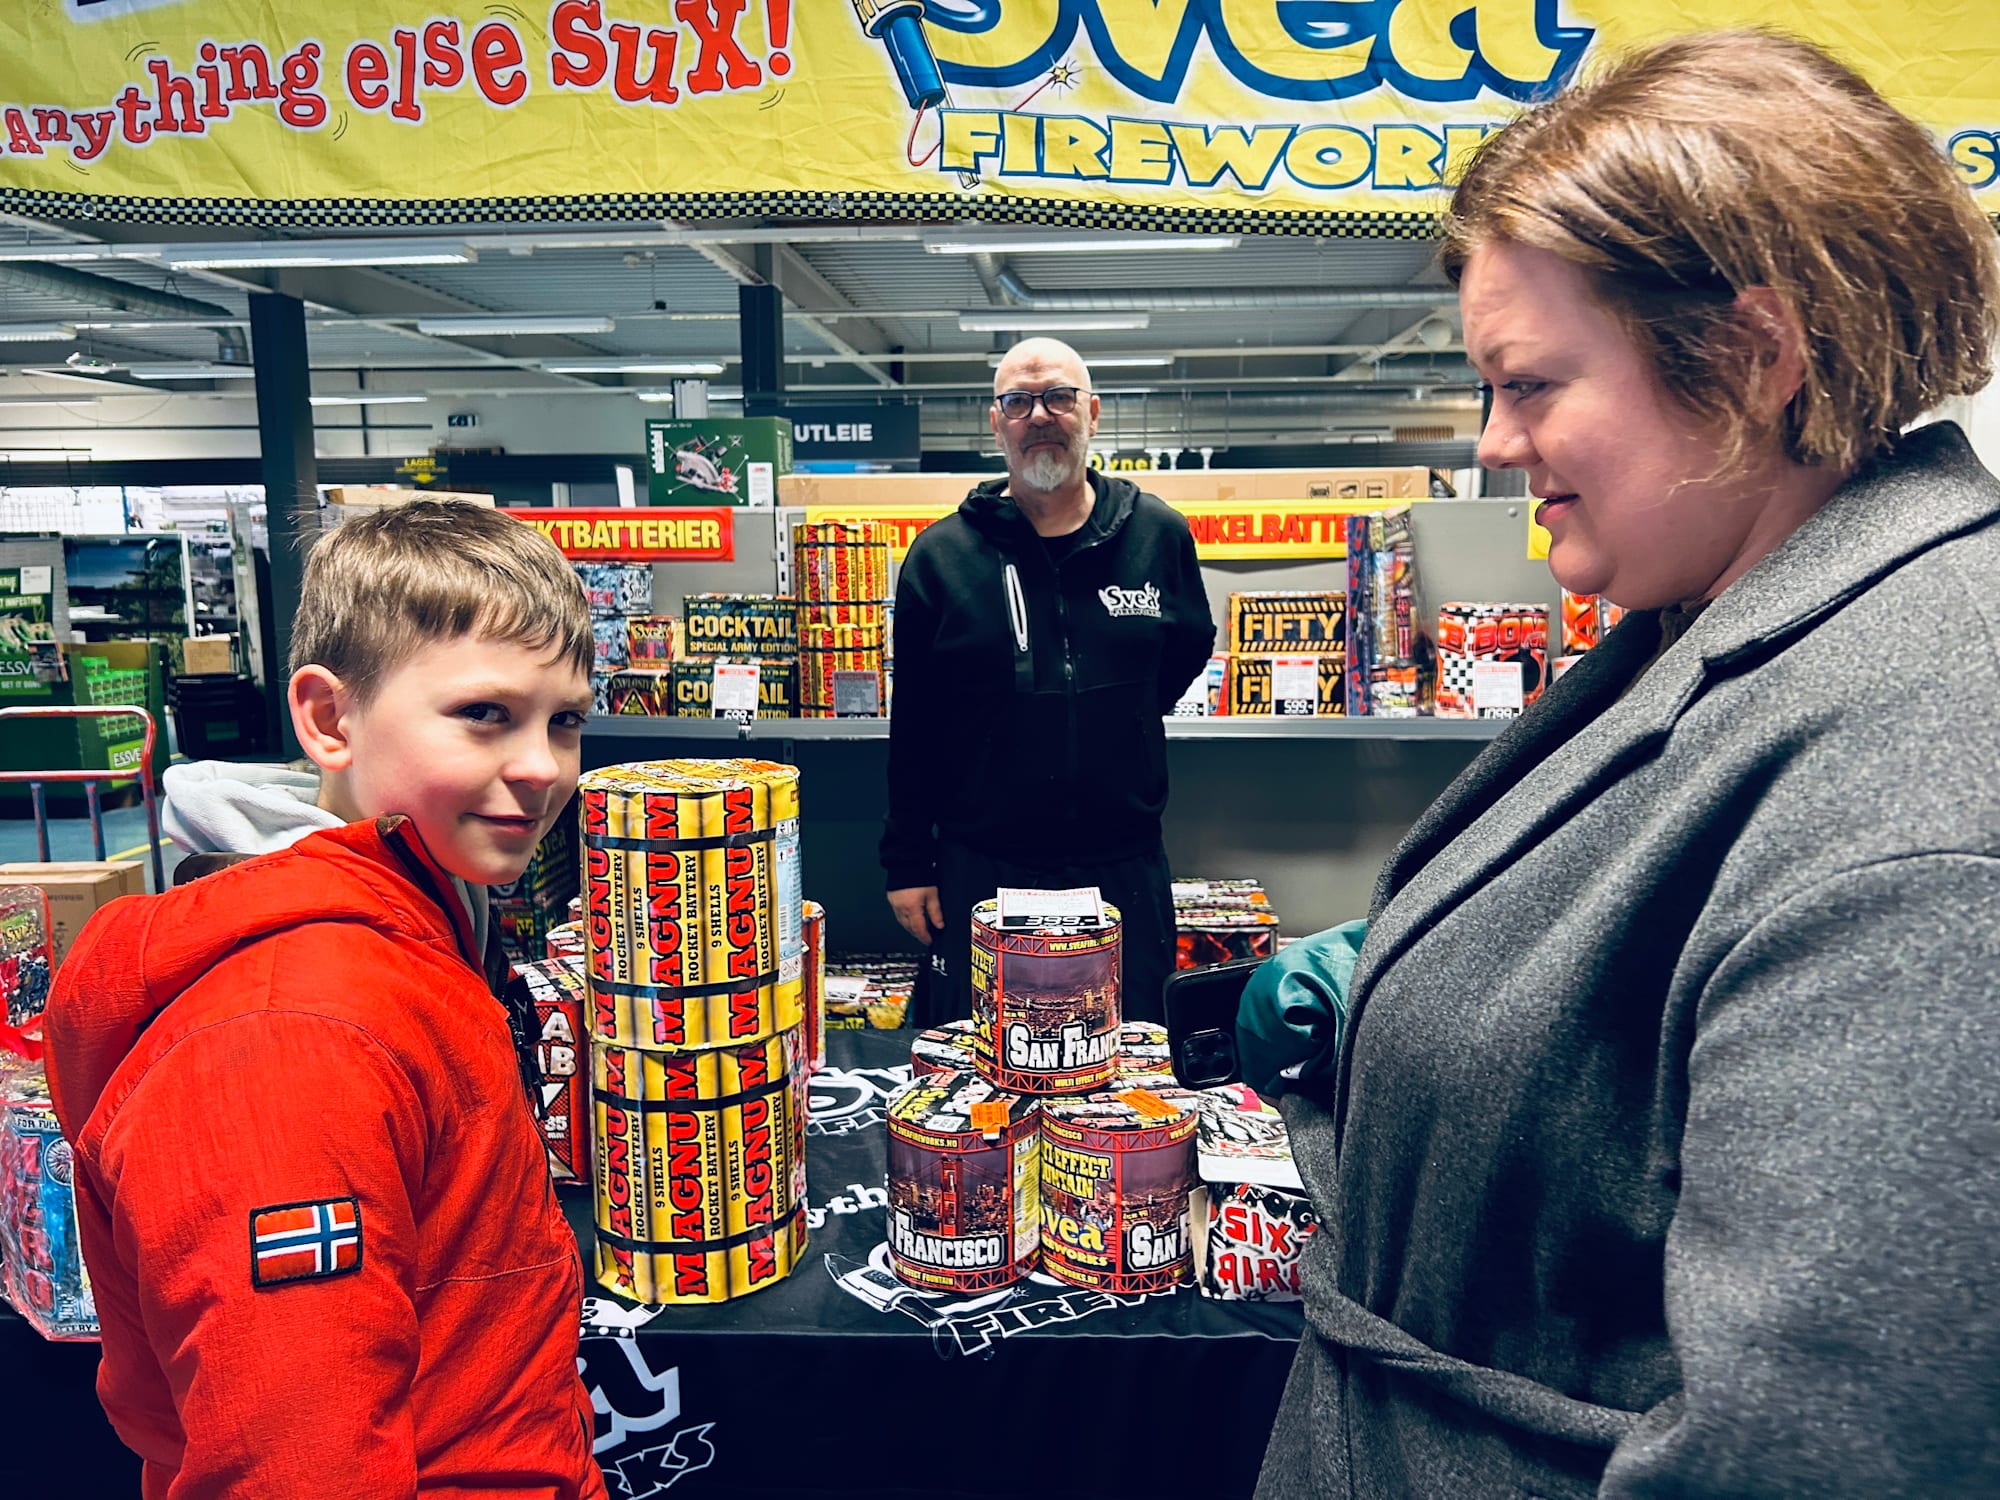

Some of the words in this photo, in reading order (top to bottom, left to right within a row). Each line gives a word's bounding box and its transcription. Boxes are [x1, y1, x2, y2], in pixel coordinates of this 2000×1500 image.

[4, 40, 331, 160] Anything
[346, 18, 528, 121] else
[795, 424, 873, 441] UTLEIE
[521, 519, 721, 549] KTBATTERIER
[1189, 514, 1347, 544] NKELBATTE
[834, 524, 849, 624] MAGNUM
[1104, 586, 1159, 609] Svea
[689, 615, 796, 637] COCKTAIL
[690, 642, 728, 652] SPECIAL
[731, 643, 758, 652] ARMY
[761, 643, 797, 652] EDITION
[1244, 613, 1341, 640] FIFTY
[0, 661, 32, 676] ESSV
[758, 710, 789, 719] DITION
[1284, 701, 1313, 714] 599.-
[113, 748, 142, 767] ESSVE
[613, 853, 624, 912] BATTERY
[685, 855, 698, 918] BATTERY
[756, 846, 767, 908] BATTERY
[584, 789, 616, 1039] MAGNUM
[633, 886, 646, 939] SHELLS
[644, 792, 686, 1044] MAGNUM
[710, 884, 721, 935] SHELLS
[723, 787, 759, 1039] MAGNUM
[1025, 915, 1097, 926] 399.-
[616, 913, 629, 980] ROCKET
[686, 920, 700, 982] ROCKET
[712, 940, 722, 948] 9
[758, 910, 770, 970] ROCKET
[1009, 1024, 1060, 1069] SAN
[545, 1116, 568, 1131] 35
[630, 1115, 644, 1175] BATTERY
[705, 1114, 720, 1175] BATTERY
[772, 1095, 783, 1157] BATTERY
[653, 1146, 664, 1196] SHELLS
[664, 1053, 709, 1296] MAGNUM
[729, 1140, 740, 1189] SHELLS
[737, 1042, 777, 1286] MAGNUM
[774, 1157, 785, 1215] ROCKET
[631, 1177, 646, 1238] ROCKET
[655, 1199, 665, 1208] 9
[709, 1178, 722, 1237] ROCKET
[731, 1193, 741, 1202] 9
[895, 1209, 1001, 1267] FRANCISCO
[1041, 1207, 1105, 1251] vea
[1131, 1224, 1178, 1270] SAN
[1224, 1206, 1291, 1256] SIX
